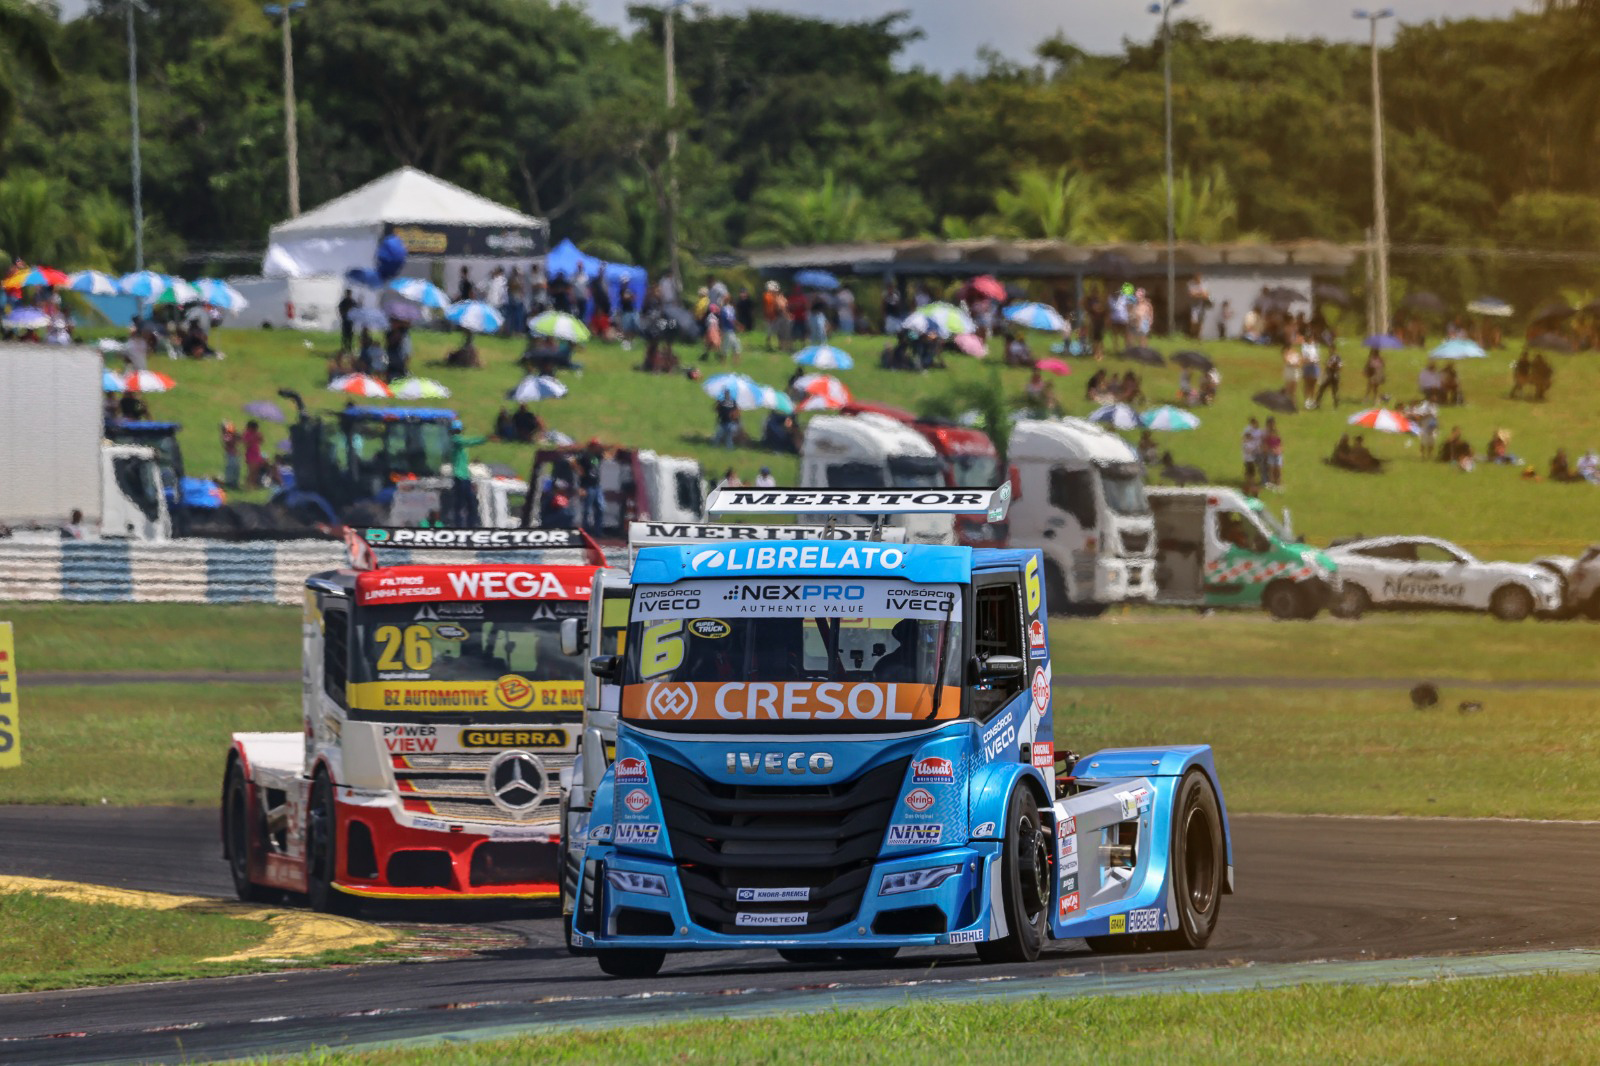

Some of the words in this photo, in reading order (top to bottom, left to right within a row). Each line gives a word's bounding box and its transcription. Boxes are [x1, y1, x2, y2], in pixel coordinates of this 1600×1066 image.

[728, 493, 983, 505] MERITOR
[393, 529, 570, 543] PROTECTOR
[727, 546, 904, 570] LIBRELATO
[380, 576, 424, 586] FILTROS
[447, 570, 568, 598] WEGA
[1025, 554, 1041, 616] 6
[365, 589, 397, 600] LINHA
[398, 586, 442, 596] PESADA
[640, 589, 701, 599] CONSÓRCIO
[741, 585, 865, 601] NEXPRO
[887, 589, 955, 599] CONSÓRCIO
[639, 599, 701, 613] IVECO
[741, 605, 817, 613] AUTHENTIC
[824, 605, 864, 613] VALUE
[886, 598, 954, 612] IVECO
[698, 625, 724, 633] TRUCK
[374, 625, 433, 671] 26
[639, 618, 685, 680] 6
[384, 689, 400, 706] BZ
[404, 689, 489, 706] AUTOMOTIVE
[541, 689, 558, 706] BZ
[715, 682, 912, 720] CRESOL
[384, 738, 438, 752] VIEW
[468, 732, 561, 745] GUERRA
[984, 725, 1015, 764] IVECO
[726, 752, 834, 775] IVECO
[913, 760, 951, 775] Usual
[906, 795, 933, 805] elring
[616, 824, 659, 838] NINO
[890, 825, 941, 839] NINO
[757, 890, 808, 898] KNORR-BREMSE
[739, 914, 805, 923] PROMETEON
[950, 930, 983, 943] MAHLE
